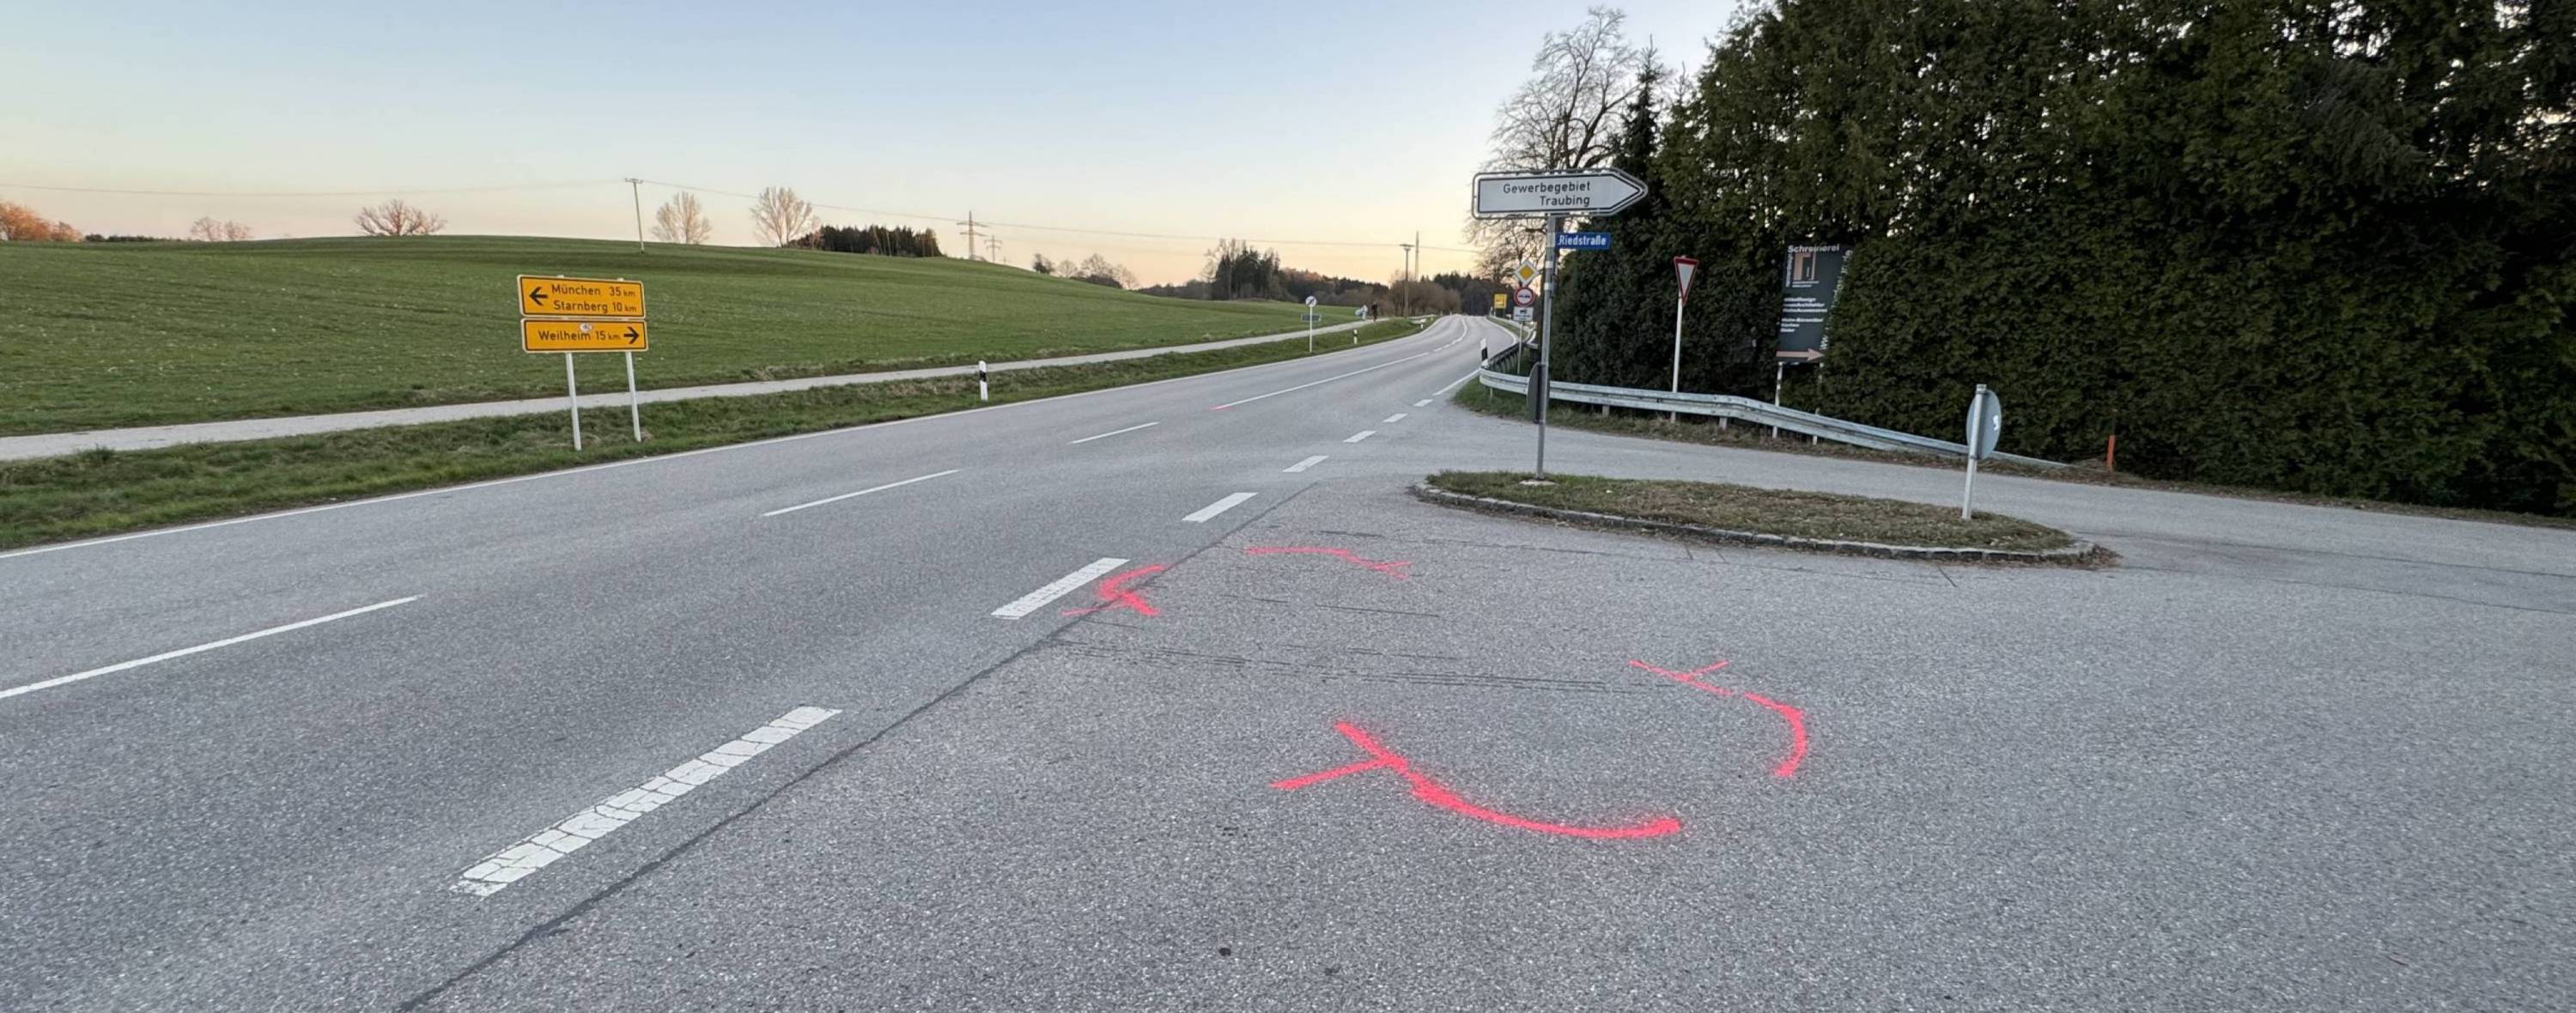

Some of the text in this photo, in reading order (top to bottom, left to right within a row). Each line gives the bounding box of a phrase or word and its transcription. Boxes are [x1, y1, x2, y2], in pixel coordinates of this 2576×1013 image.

[1503, 181, 1591, 194] Gewerbegebiet
[1540, 196, 1590, 207] Traubing
[1558, 234, 1607, 246] Riedstraße
[551, 283, 635, 297] München 35 km
[553, 300, 637, 313] Starnberg 10 km
[538, 330, 621, 341] Weilheim 15 km
